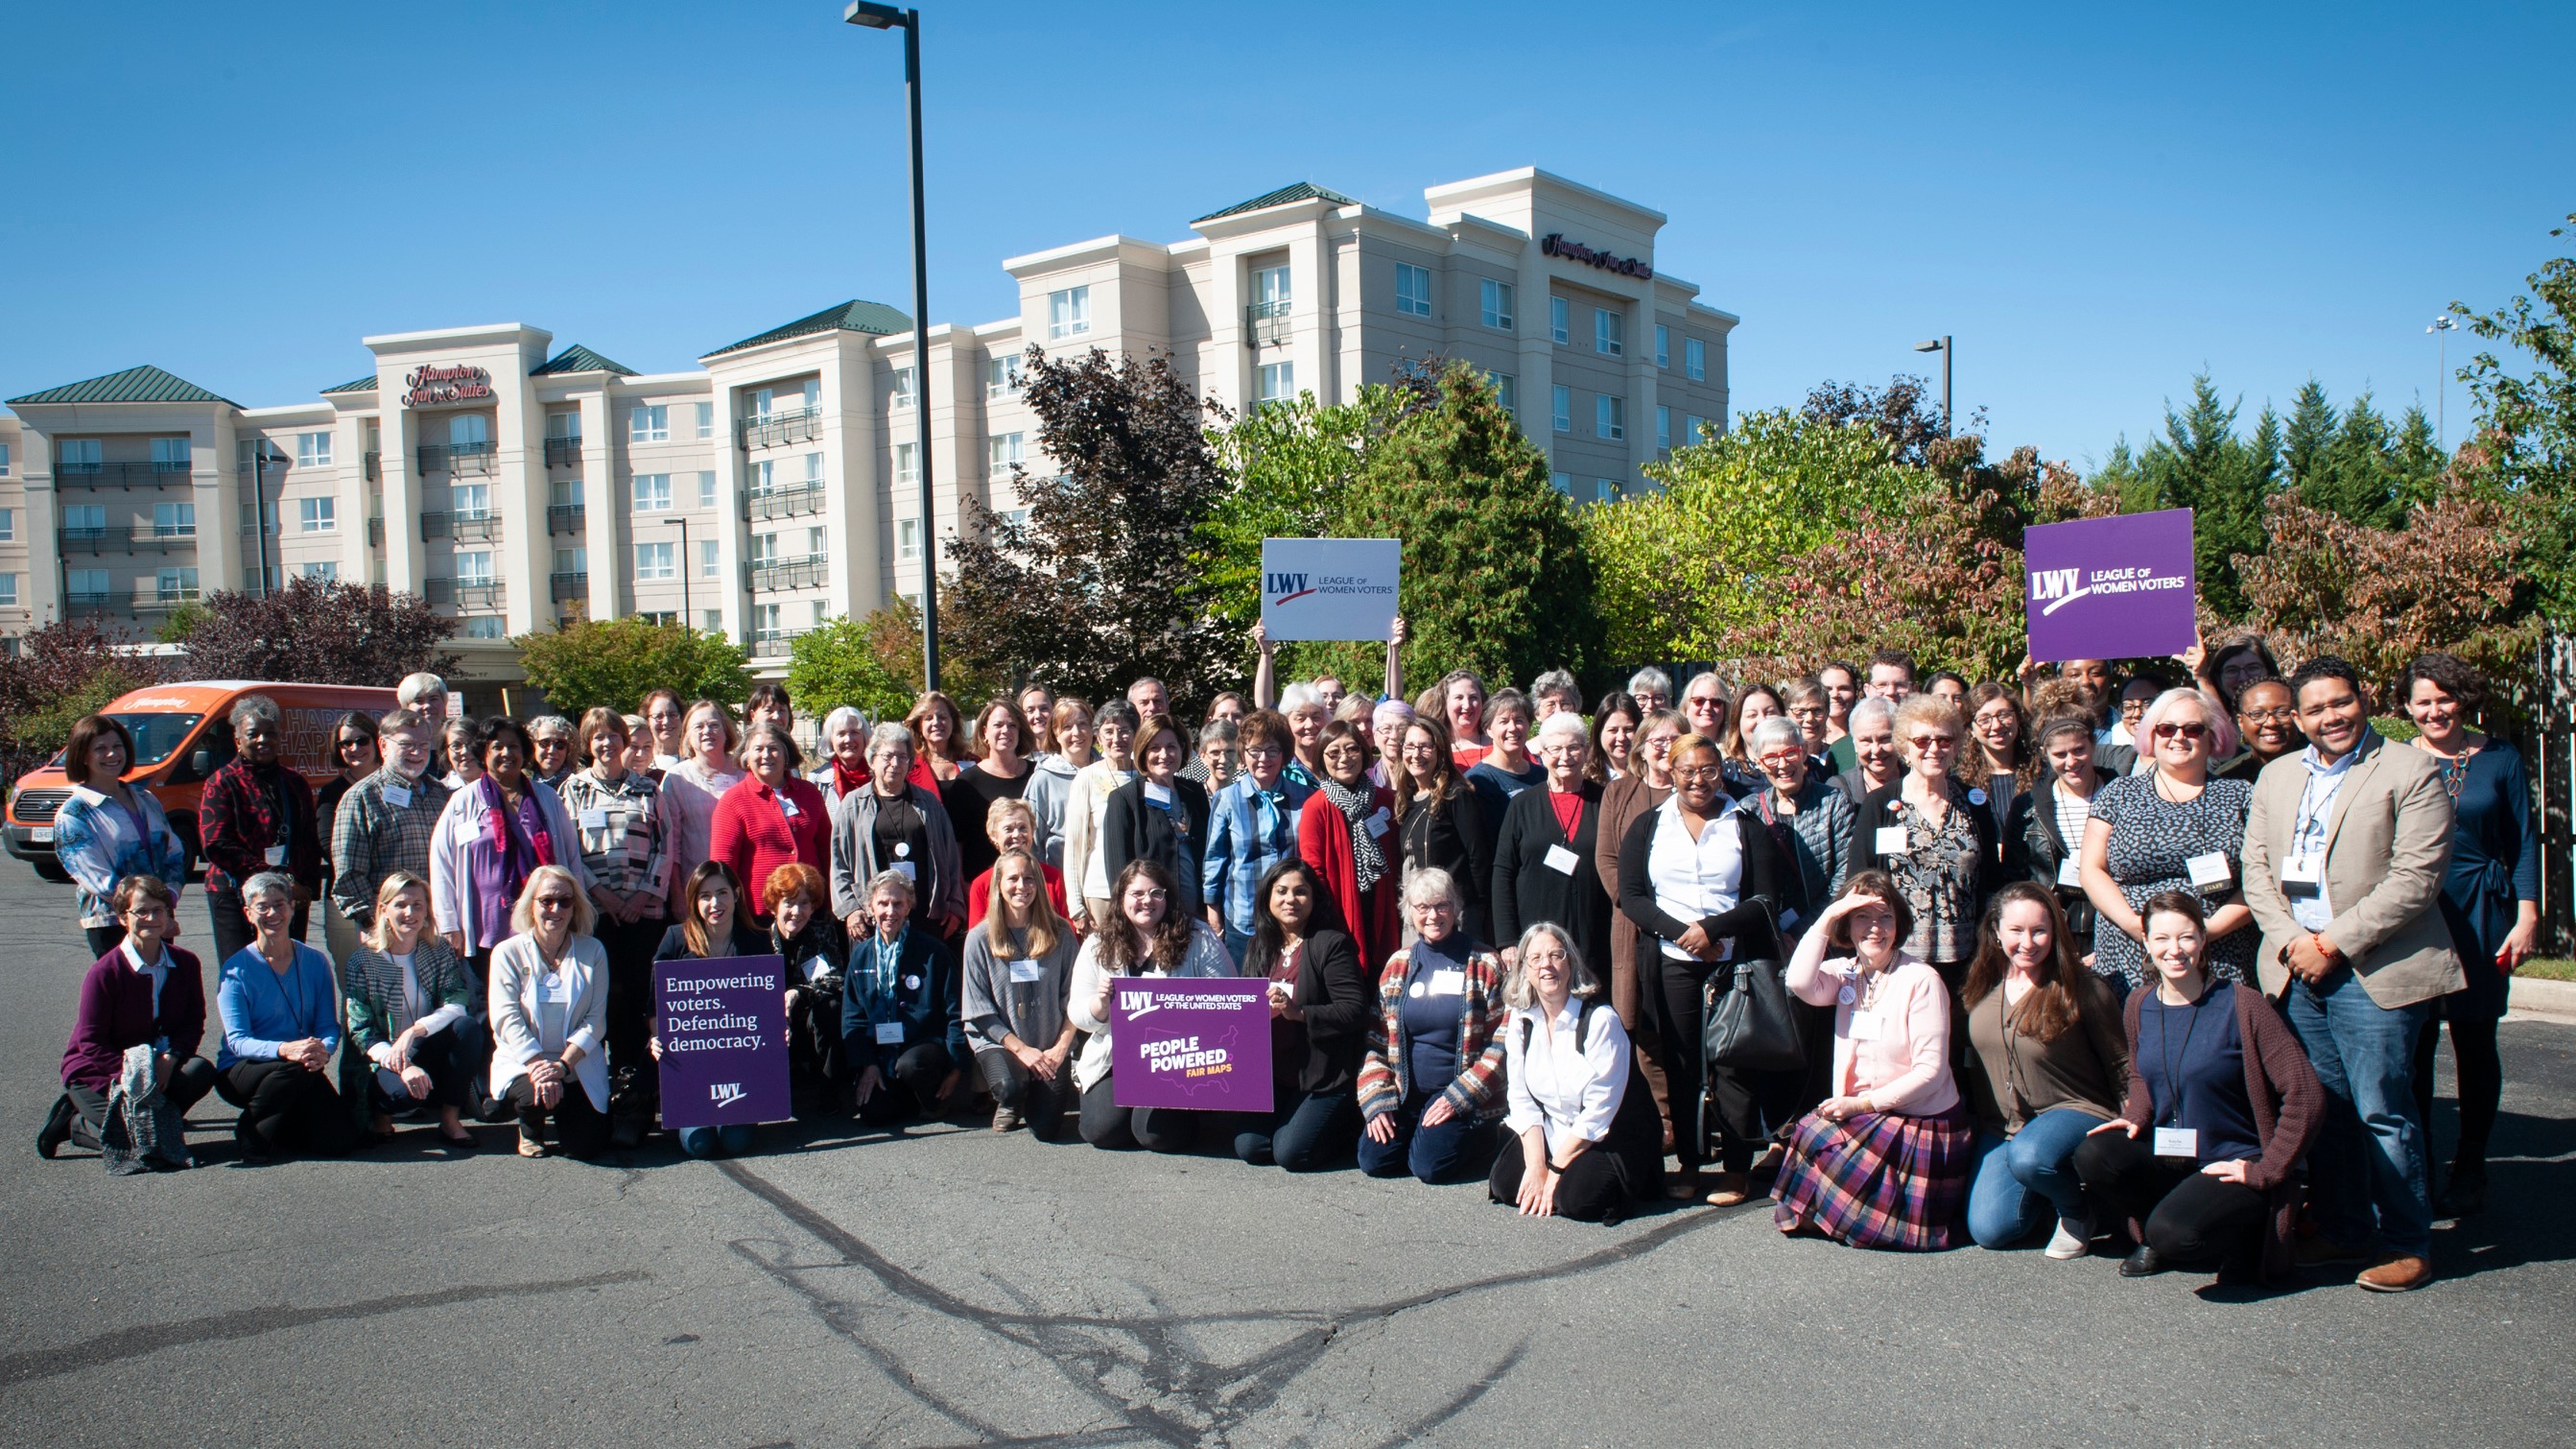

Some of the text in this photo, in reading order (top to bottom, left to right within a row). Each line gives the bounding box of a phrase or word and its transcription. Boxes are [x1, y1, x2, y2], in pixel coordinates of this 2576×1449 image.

[1542, 233, 1598, 265] Hampton
[406, 364, 486, 387] Hampton
[401, 386, 439, 407] Inn
[446, 383, 491, 401] Suites
[1266, 573, 1309, 594] LWV
[1318, 577, 1355, 585] LEAGUE
[2031, 567, 2080, 601] LWV
[2091, 567, 2152, 582] LEAGUE OF
[1318, 585, 1356, 594] WOMEN
[2091, 581, 2138, 595] WOMEN
[123, 698, 191, 711] Hampton
[295, 752, 340, 776] ALL
[2204, 883, 2223, 891] STAFF
[666, 972, 775, 995] Empowering
[666, 997, 726, 1012] voters.
[1120, 991, 1153, 1010] LWV
[1155, 993, 1185, 1002] LEAGUE
[1194, 994, 1224, 1003] WOMEN
[1190, 1002, 1217, 1010] UNITED
[1217, 1002, 1242, 1010] STATES
[667, 1013, 758, 1033] Defending
[668, 1034, 767, 1053] democracy.
[1140, 1035, 1199, 1059] PEOPLE
[1150, 1048, 1227, 1074] POWERED
[1186, 1063, 1233, 1079] FAIR MAPS
[710, 1082, 742, 1101] LWV
